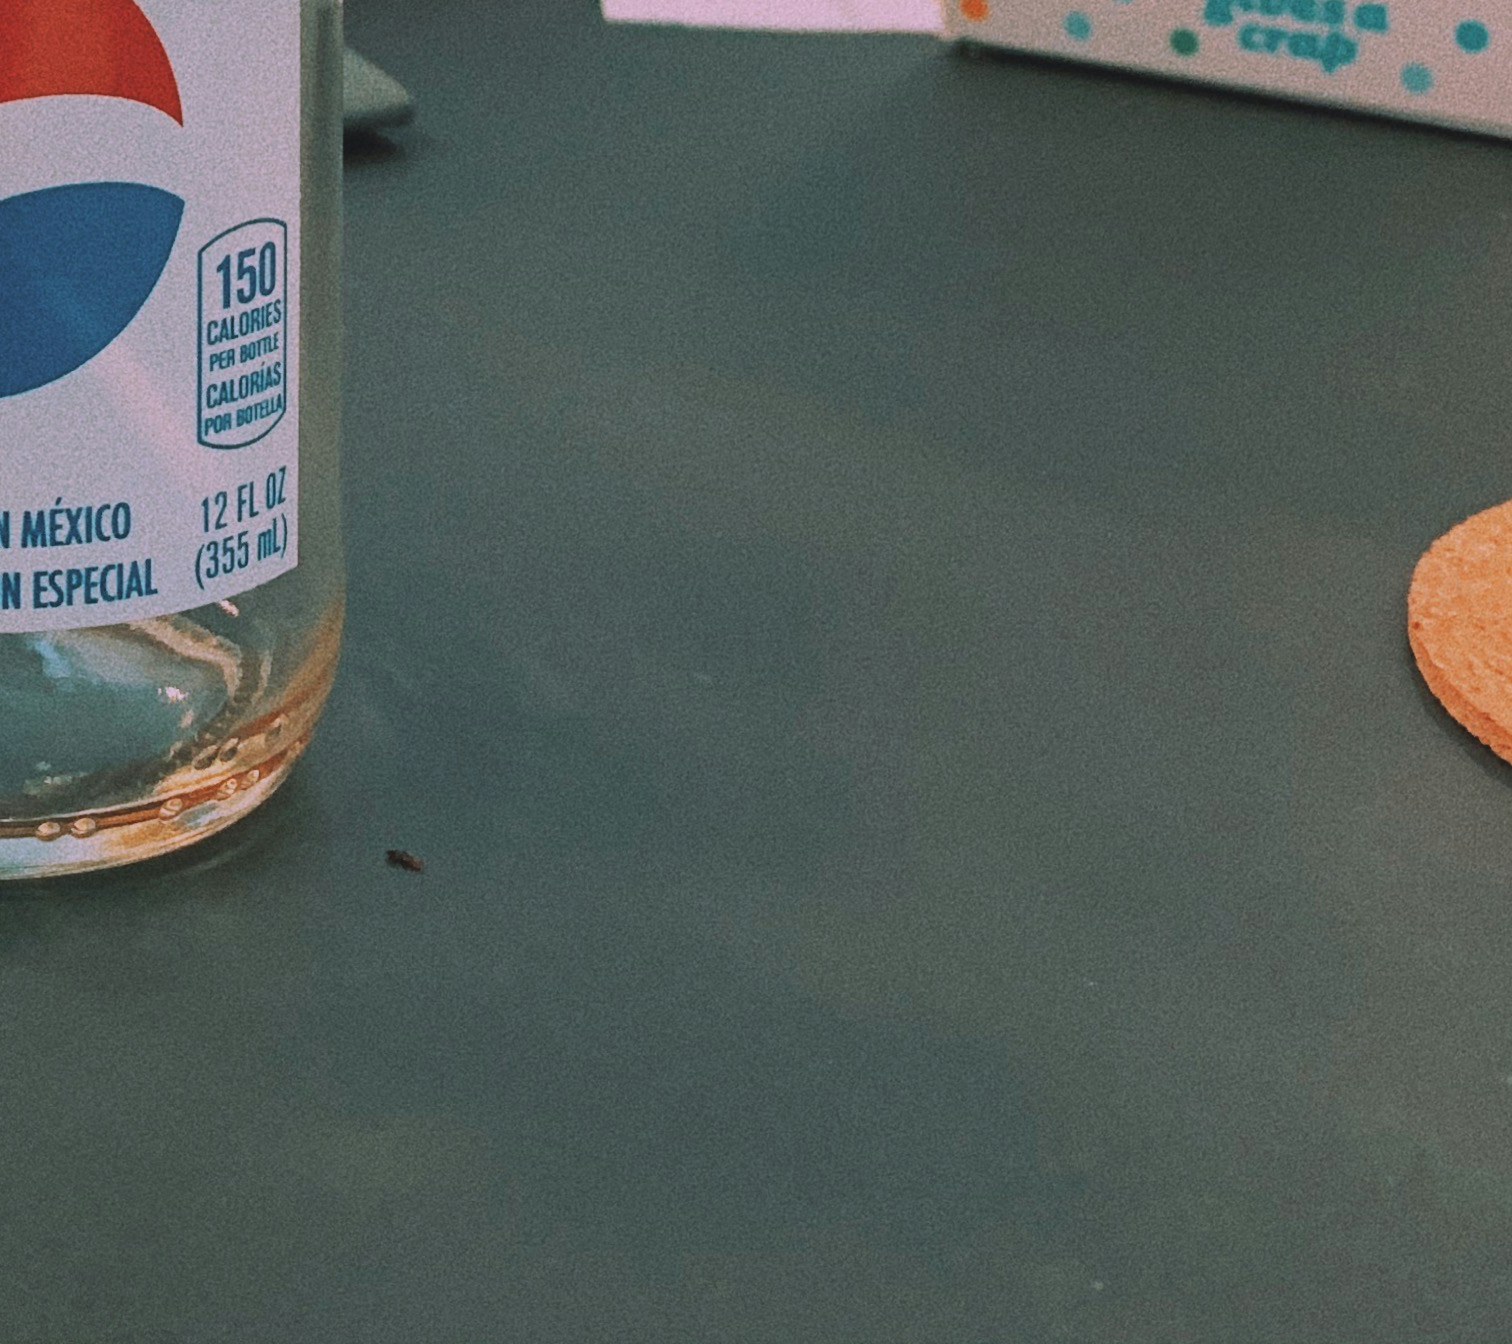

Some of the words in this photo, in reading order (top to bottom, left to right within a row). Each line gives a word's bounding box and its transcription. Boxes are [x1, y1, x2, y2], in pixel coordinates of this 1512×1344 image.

[216, 240, 276, 309] 150
[207, 299, 282, 346] CALORIES
[209, 350, 236, 372] PER
[239, 331, 280, 364] BOTTLE
[206, 361, 282, 409] CALORÍAS
[204, 414, 233, 437] POR
[236, 393, 285, 429] BOTELLA
[21, 496, 132, 549] MÉXICO
[200, 490, 228, 533] 12
[237, 481, 259, 524] FL
[265, 465, 287, 511] OZ
[194, 530, 250, 591] (355
[256, 512, 288, 562] mL)
[33, 558, 159, 610] ESPECIAL
